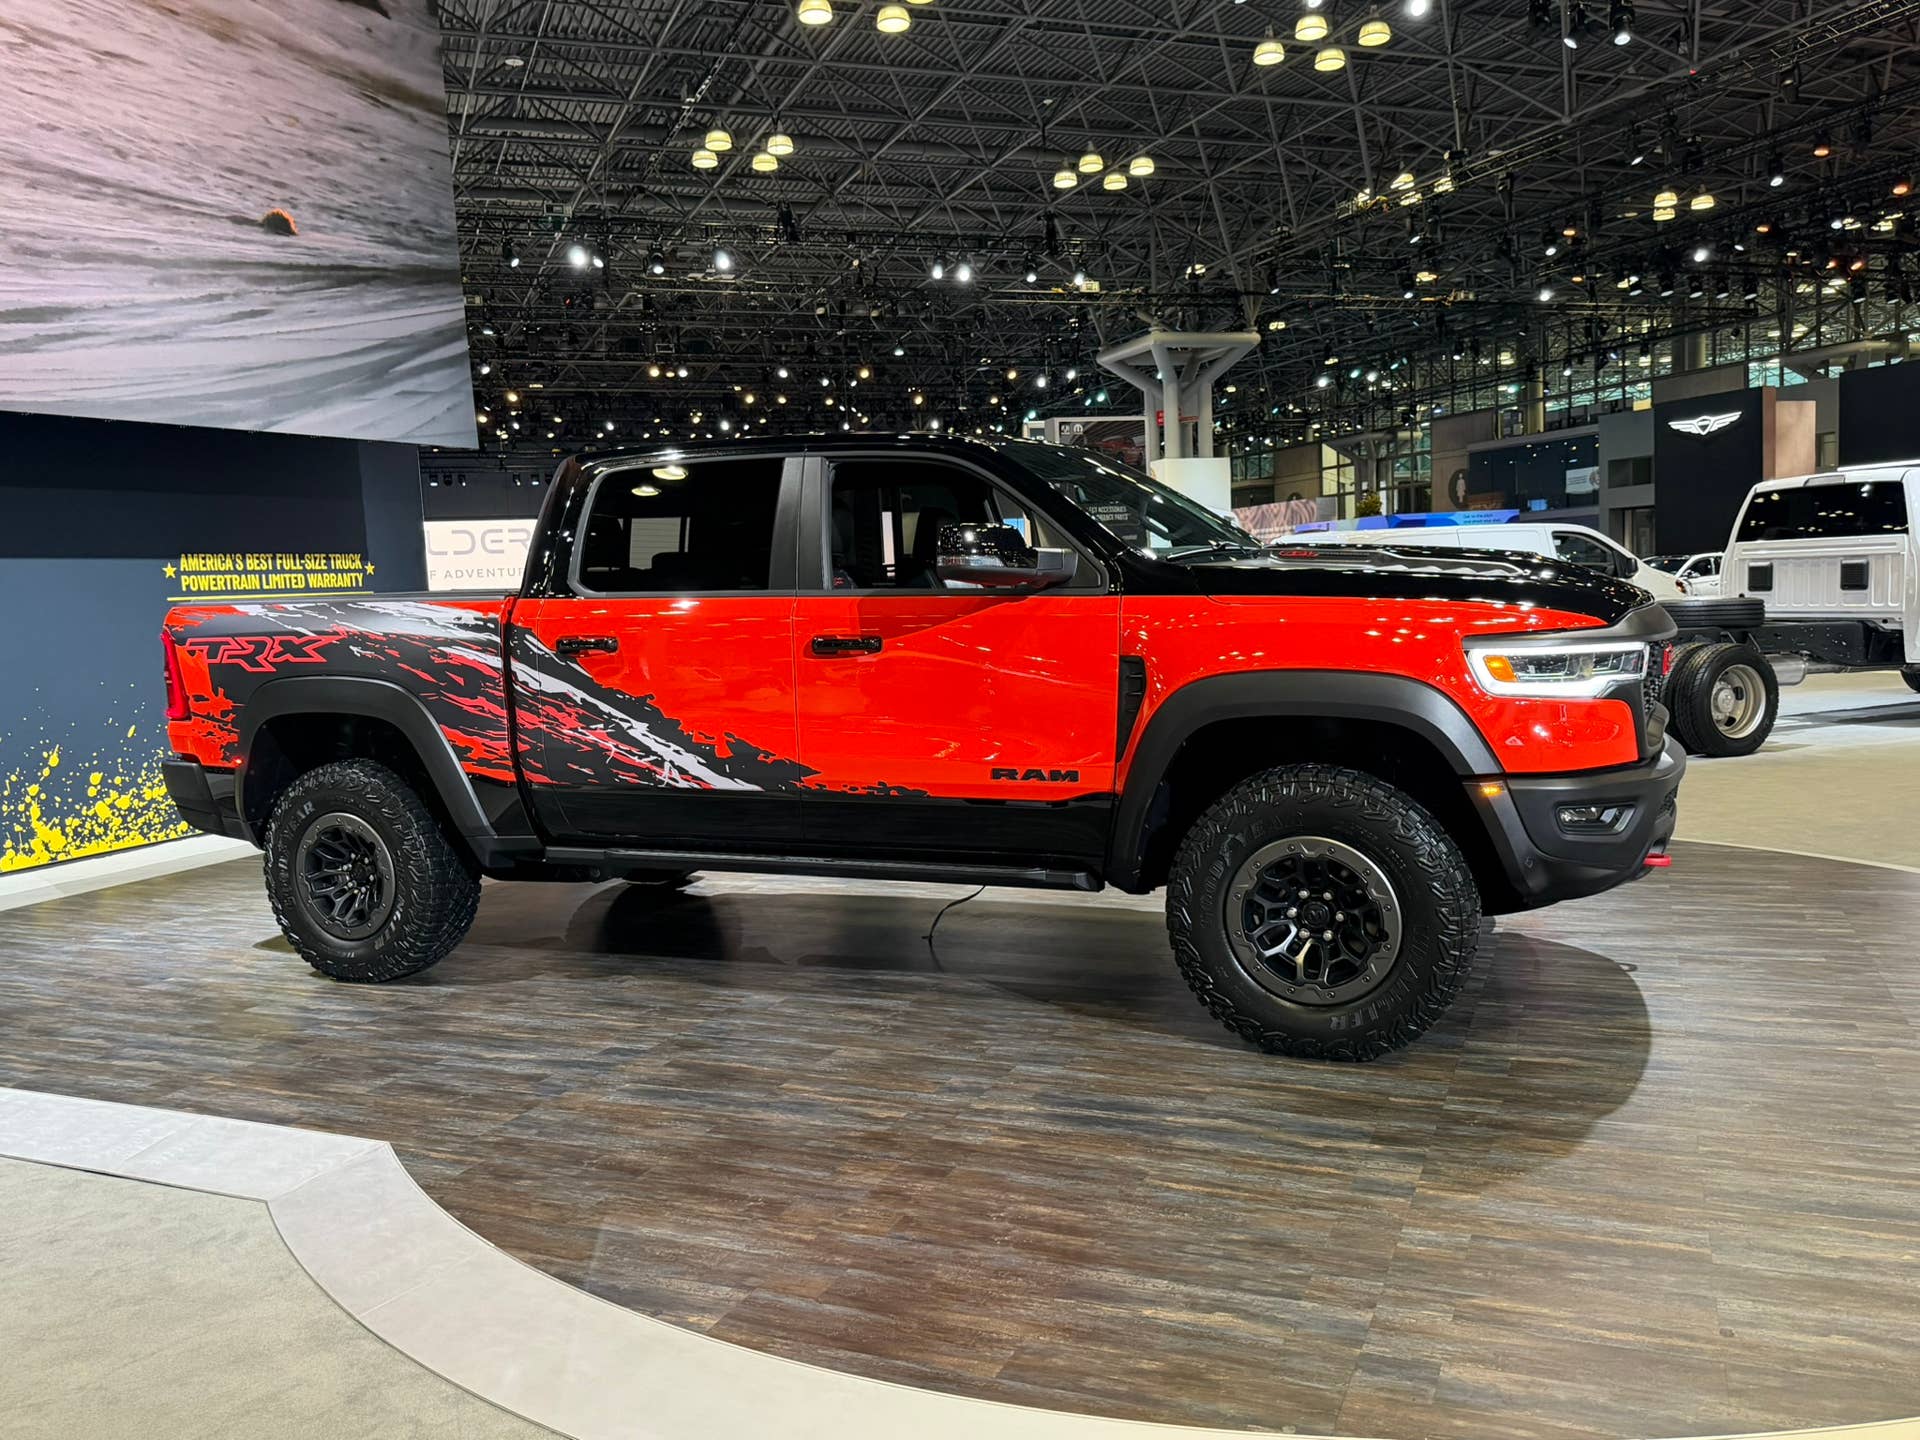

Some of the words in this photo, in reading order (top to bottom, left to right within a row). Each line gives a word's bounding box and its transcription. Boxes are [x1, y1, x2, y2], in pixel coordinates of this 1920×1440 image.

[180, 553, 244, 571] AMERICA'S
[245, 553, 273, 571] BEST
[276, 553, 328, 570] FULL-SIZE
[329, 553, 362, 570] TRUCK
[181, 574, 261, 592] POWERTRAIN
[262, 573, 305, 590] LIMITED
[307, 572, 364, 589] WARRANTY
[186, 633, 345, 672] TRX
[992, 767, 1080, 783] RAM
